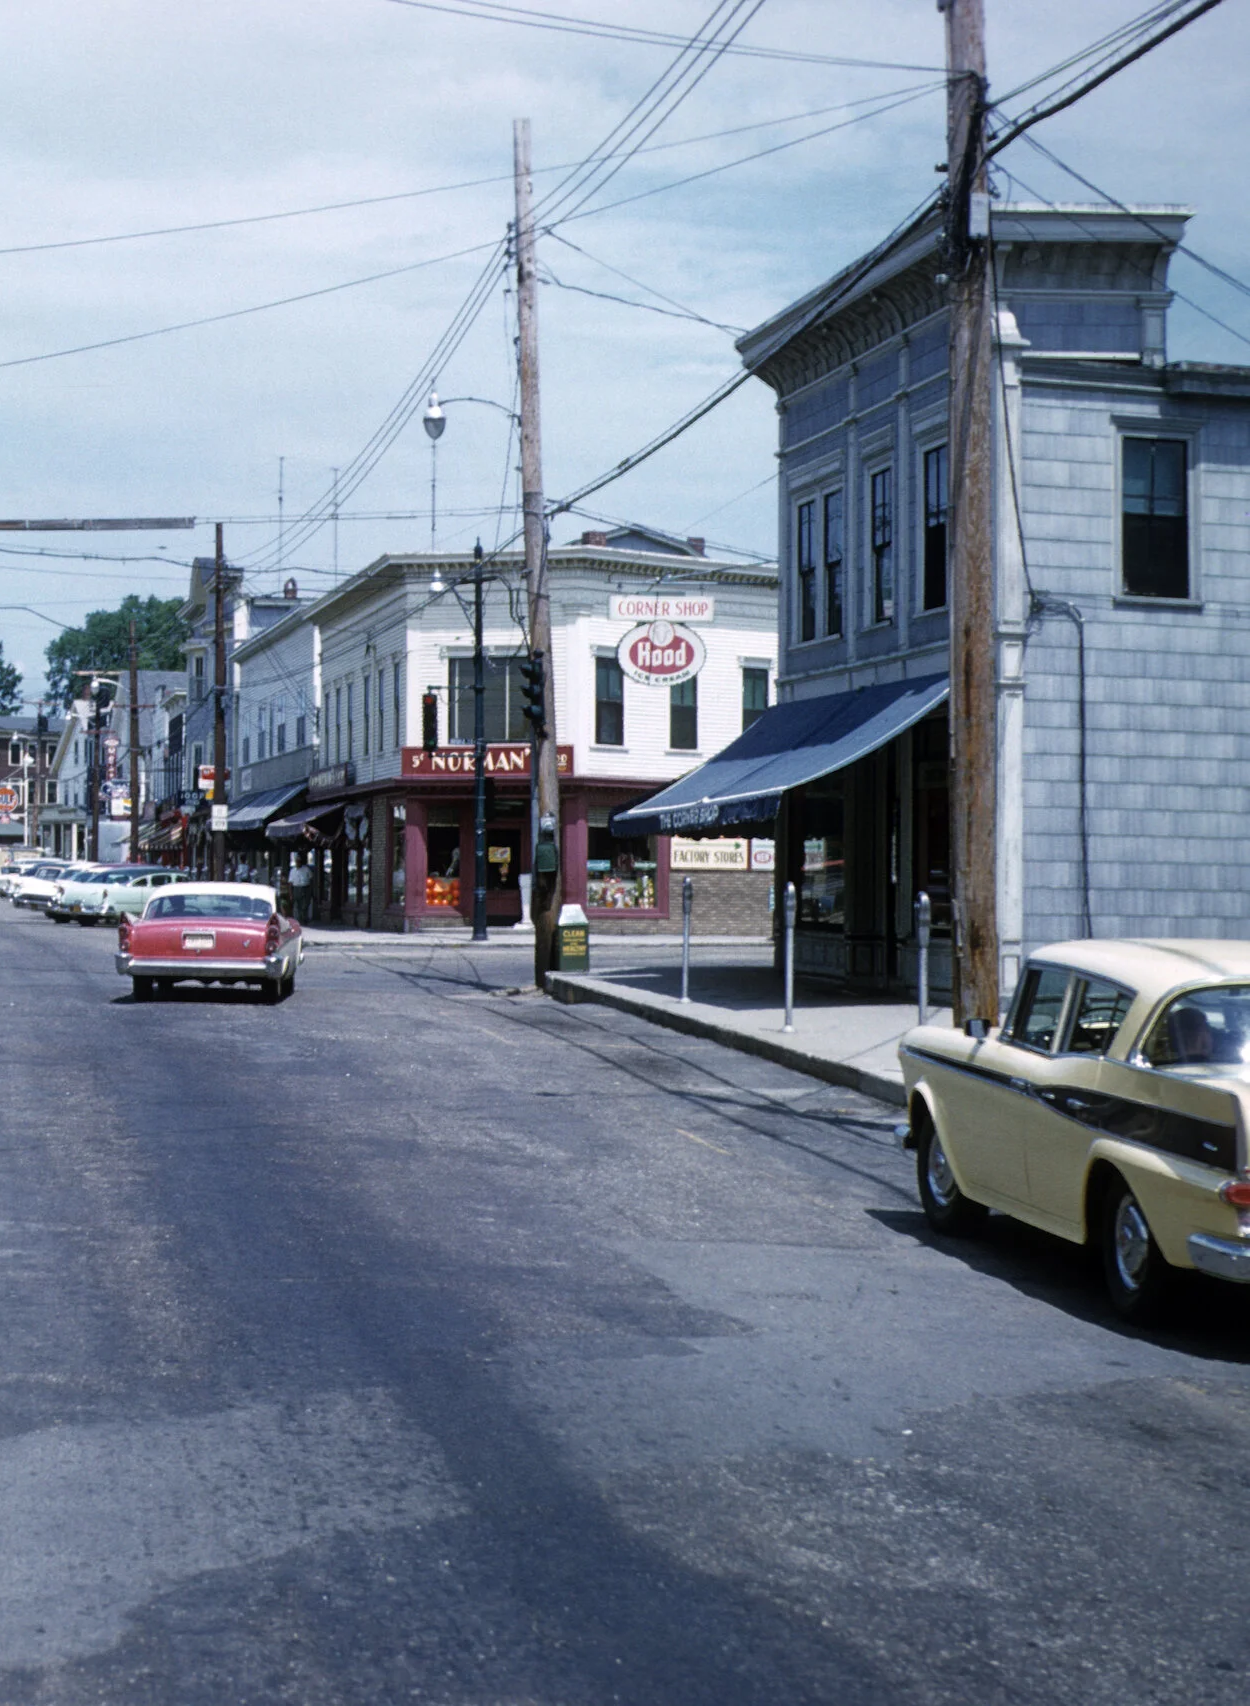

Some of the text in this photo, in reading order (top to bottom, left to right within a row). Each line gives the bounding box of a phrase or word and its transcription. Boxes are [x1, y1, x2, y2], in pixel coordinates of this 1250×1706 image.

[618, 600, 709, 616] CORNER SHOP
[637, 641, 687, 667] Hood
[634, 669, 691, 682] ICE CREAM
[431, 748, 530, 771] NORMAN'
[674, 850, 710, 863] FACTORY
[714, 850, 744, 864] STORES
